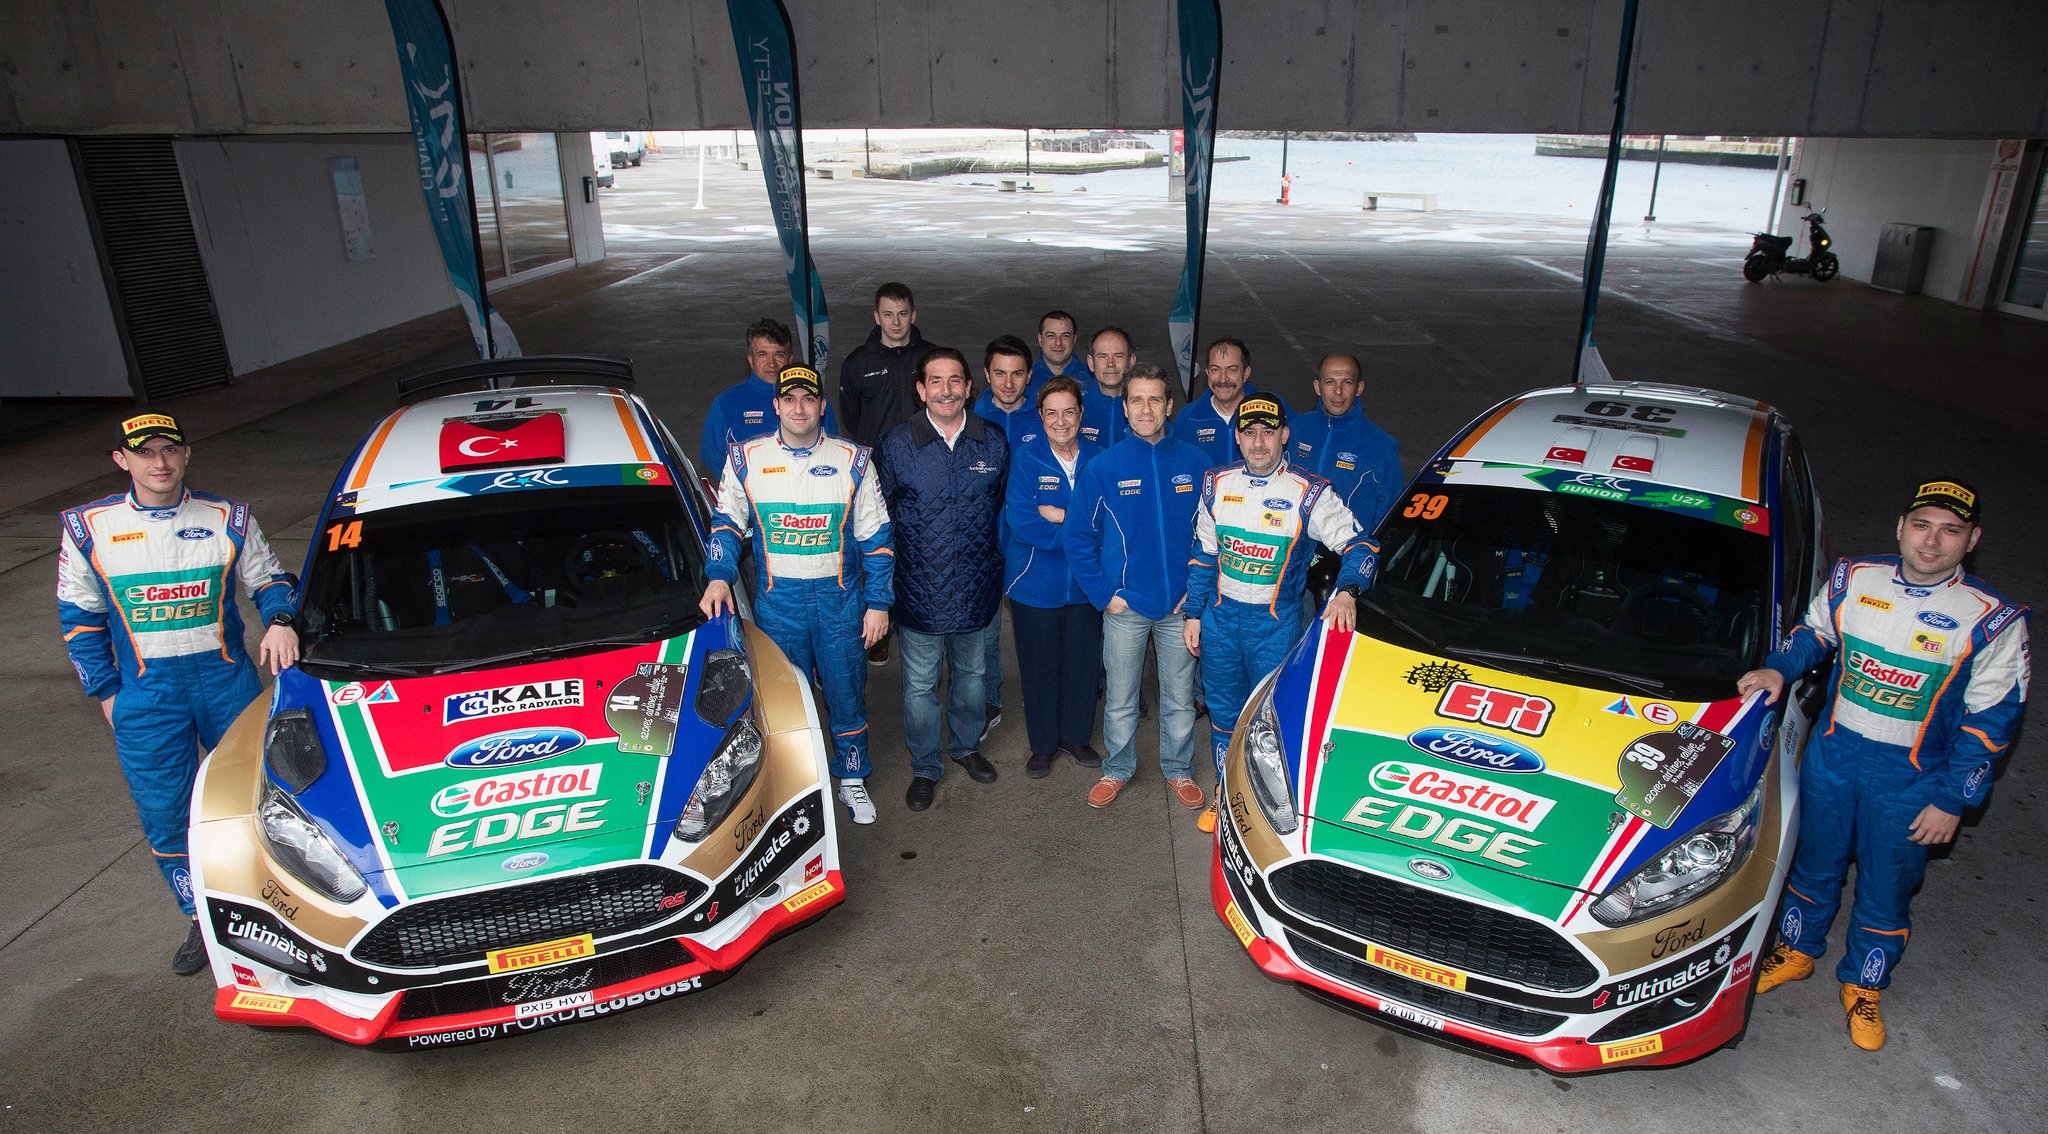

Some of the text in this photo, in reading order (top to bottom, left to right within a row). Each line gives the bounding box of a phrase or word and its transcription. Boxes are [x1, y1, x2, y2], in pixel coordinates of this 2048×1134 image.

[1241, 403, 1276, 413] PIRELLI
[1584, 400, 1676, 424] 39
[127, 416, 178, 430] PIRELLI
[763, 466, 786, 474] PIRELLI
[1561, 484, 1624, 500] JUNIOR
[1671, 493, 1706, 507] U27
[1921, 484, 1972, 503] PIRELLI
[1403, 493, 1449, 520] 39
[66, 513, 85, 539] sparco
[183, 528, 208, 539] Ford
[783, 514, 828, 529] Castrol
[111, 532, 145, 544] PIRELLI
[327, 520, 363, 552] 14
[770, 531, 833, 546] EDGE
[1232, 538, 1274, 559] Castrol
[1222, 553, 1278, 577] EDGE
[146, 580, 209, 602] Castrol
[432, 568, 446, 608] sparco
[131, 600, 216, 624] EDGE
[1859, 595, 1891, 610] PIRELLI
[1923, 613, 1953, 628] Ford
[1987, 606, 2014, 632] sparco
[1862, 658, 1922, 690] Castrol
[489, 679, 582, 704] KALE
[610, 695, 640, 712] 14
[1843, 672, 1926, 710] EDGE
[463, 698, 487, 712] KL
[491, 695, 581, 714] OTO RADYATOR
[1442, 684, 1549, 735] ETi
[470, 732, 562, 764] Ford
[1428, 728, 1524, 772] Ford
[1626, 742, 1666, 771] 39
[474, 770, 594, 809] Castrol
[1644, 781, 1666, 804] azores
[1660, 758, 1685, 782] airlines
[1966, 766, 1986, 791] Ford
[1408, 770, 1538, 826] Castrol
[1230, 791, 1252, 838] Ford
[427, 798, 613, 859] EDGE
[734, 804, 765, 853] Ford
[1342, 796, 1547, 868] EDGE
[510, 855, 543, 870] Ford
[735, 830, 792, 897] ultimate
[1416, 862, 1443, 878] Ford
[733, 873, 743, 884] bp
[261, 879, 300, 921] Ford
[657, 890, 687, 912] RS
[789, 883, 829, 909] PIRELLI
[230, 910, 242, 922] bp
[1228, 907, 1251, 941] PIRELLI
[227, 920, 309, 965] ultimate
[1651, 918, 1706, 960] Ford
[497, 938, 585, 970] PIRELLI
[1374, 948, 1459, 987] PIRELLI
[1864, 953, 1883, 984] Ford
[502, 967, 595, 1004] Ford
[1616, 958, 1711, 1006] ultimate
[1618, 983, 1630, 992] bp
[238, 995, 288, 1010] PIRELLI
[521, 994, 588, 1016] PX15 HVY
[1385, 1003, 1440, 1029] 26 UD 777
[408, 1027, 476, 1048] Powered
[478, 1021, 498, 1038] by
[1607, 1038, 1657, 1059] PIRELLI
